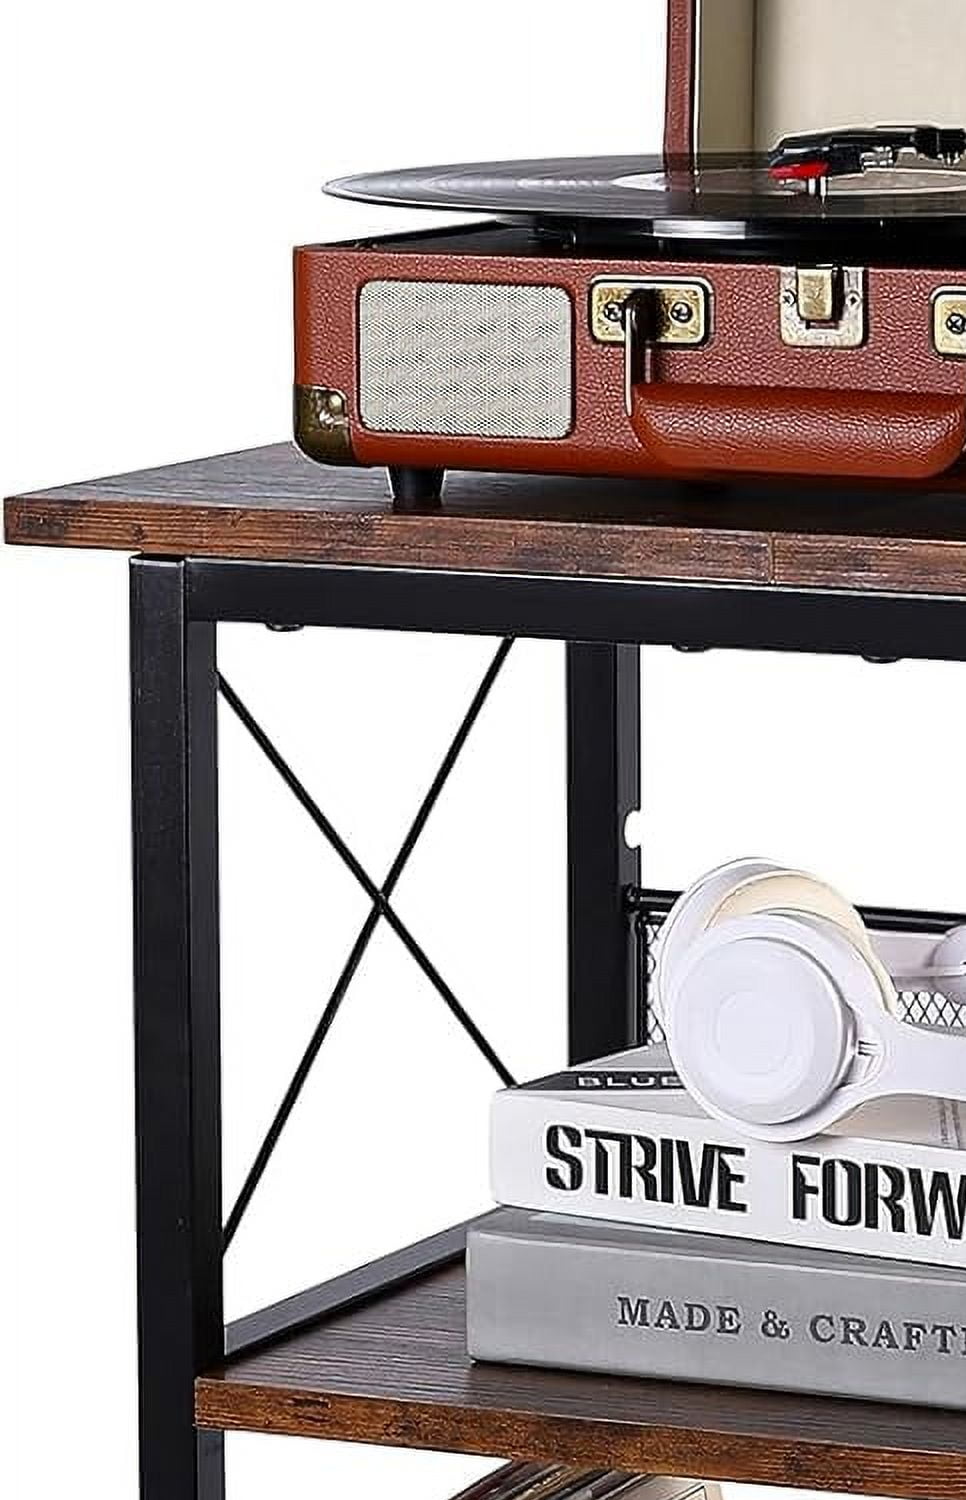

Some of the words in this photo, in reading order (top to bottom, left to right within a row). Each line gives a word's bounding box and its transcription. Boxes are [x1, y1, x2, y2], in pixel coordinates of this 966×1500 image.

[546, 1125, 747, 1212] STRIVE
[617, 1296, 741, 1334] MADE
[761, 1310, 790, 1339] &
